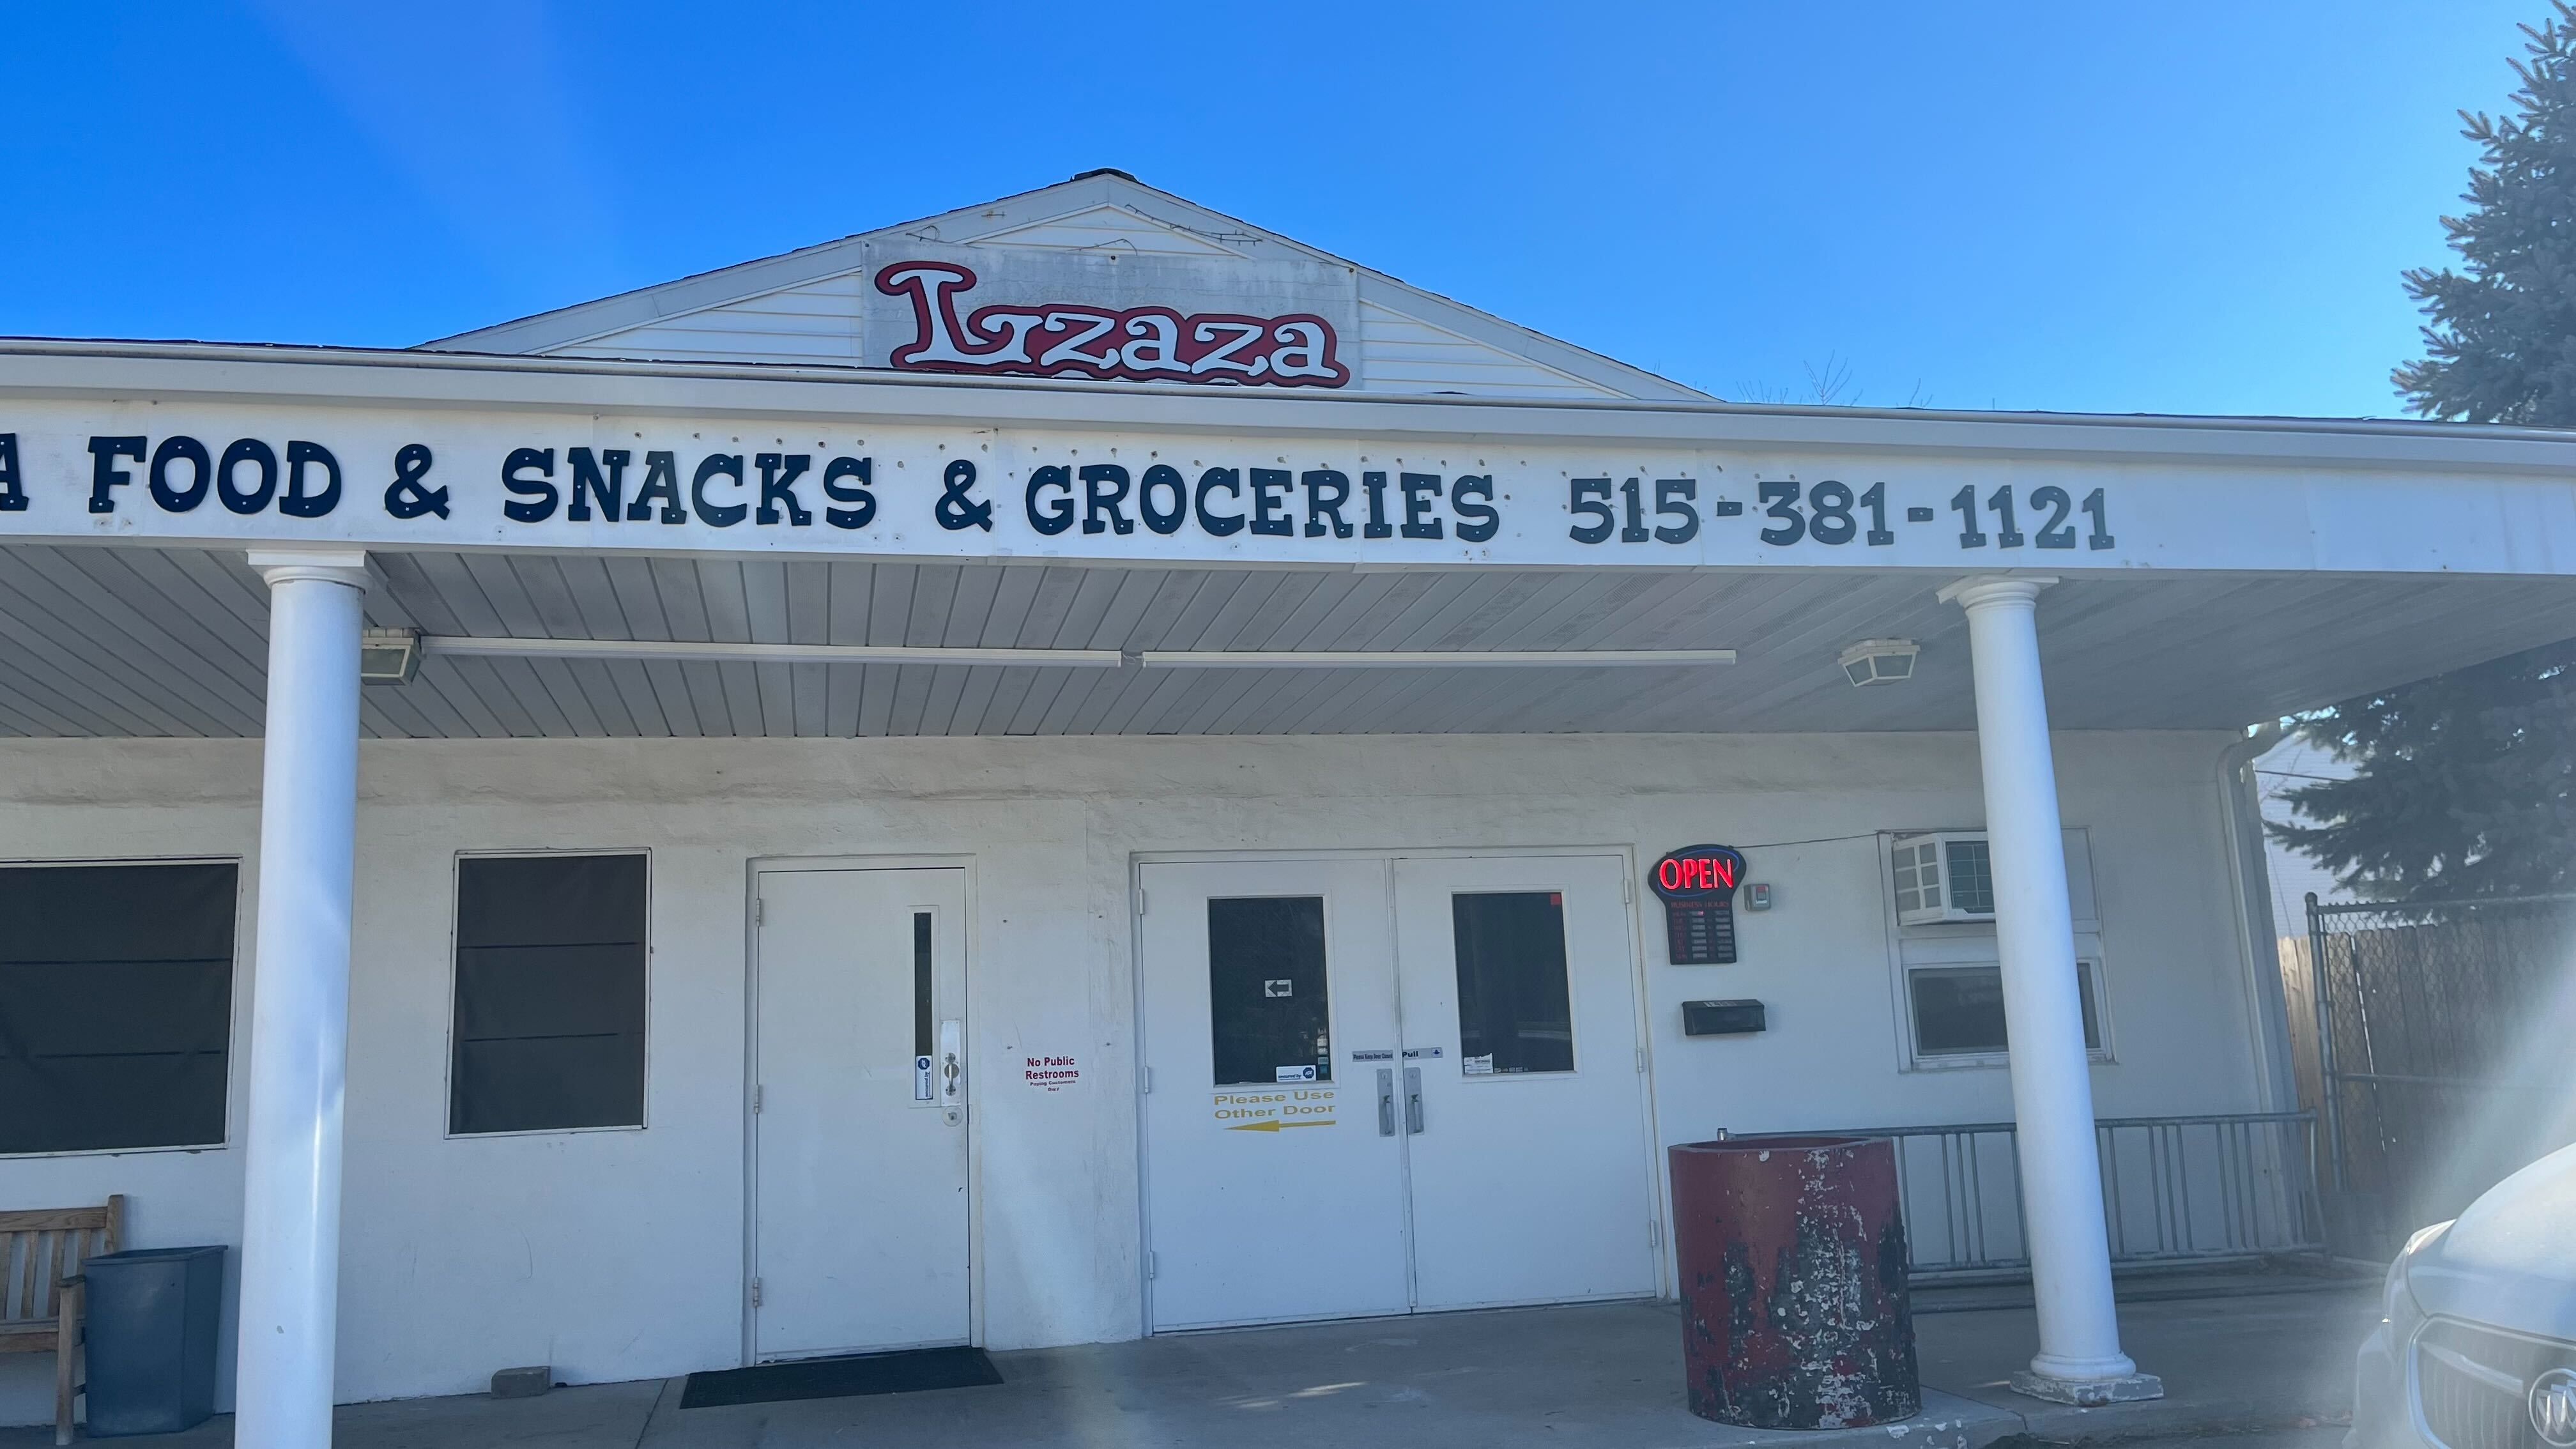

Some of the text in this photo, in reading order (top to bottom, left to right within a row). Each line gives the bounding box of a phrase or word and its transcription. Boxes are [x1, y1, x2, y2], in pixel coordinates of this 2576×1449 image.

[878, 263, 1347, 385] Lzaza
[87, 435, 342, 518] FOOD
[384, 443, 450, 521] &
[502, 447, 877, 530] SNACKS
[935, 459, 993, 532] &
[1025, 464, 1499, 543] GROCERIES
[1569, 477, 2115, 551] 515-381-1121
[1659, 858, 1734, 890] OPEN
[1027, 1055, 1075, 1067] No Public
[1025, 1070, 1079, 1080] Restrooms
[1214, 1091, 1335, 1106] Please Use
[1215, 1105, 1337, 1119] Other Door
